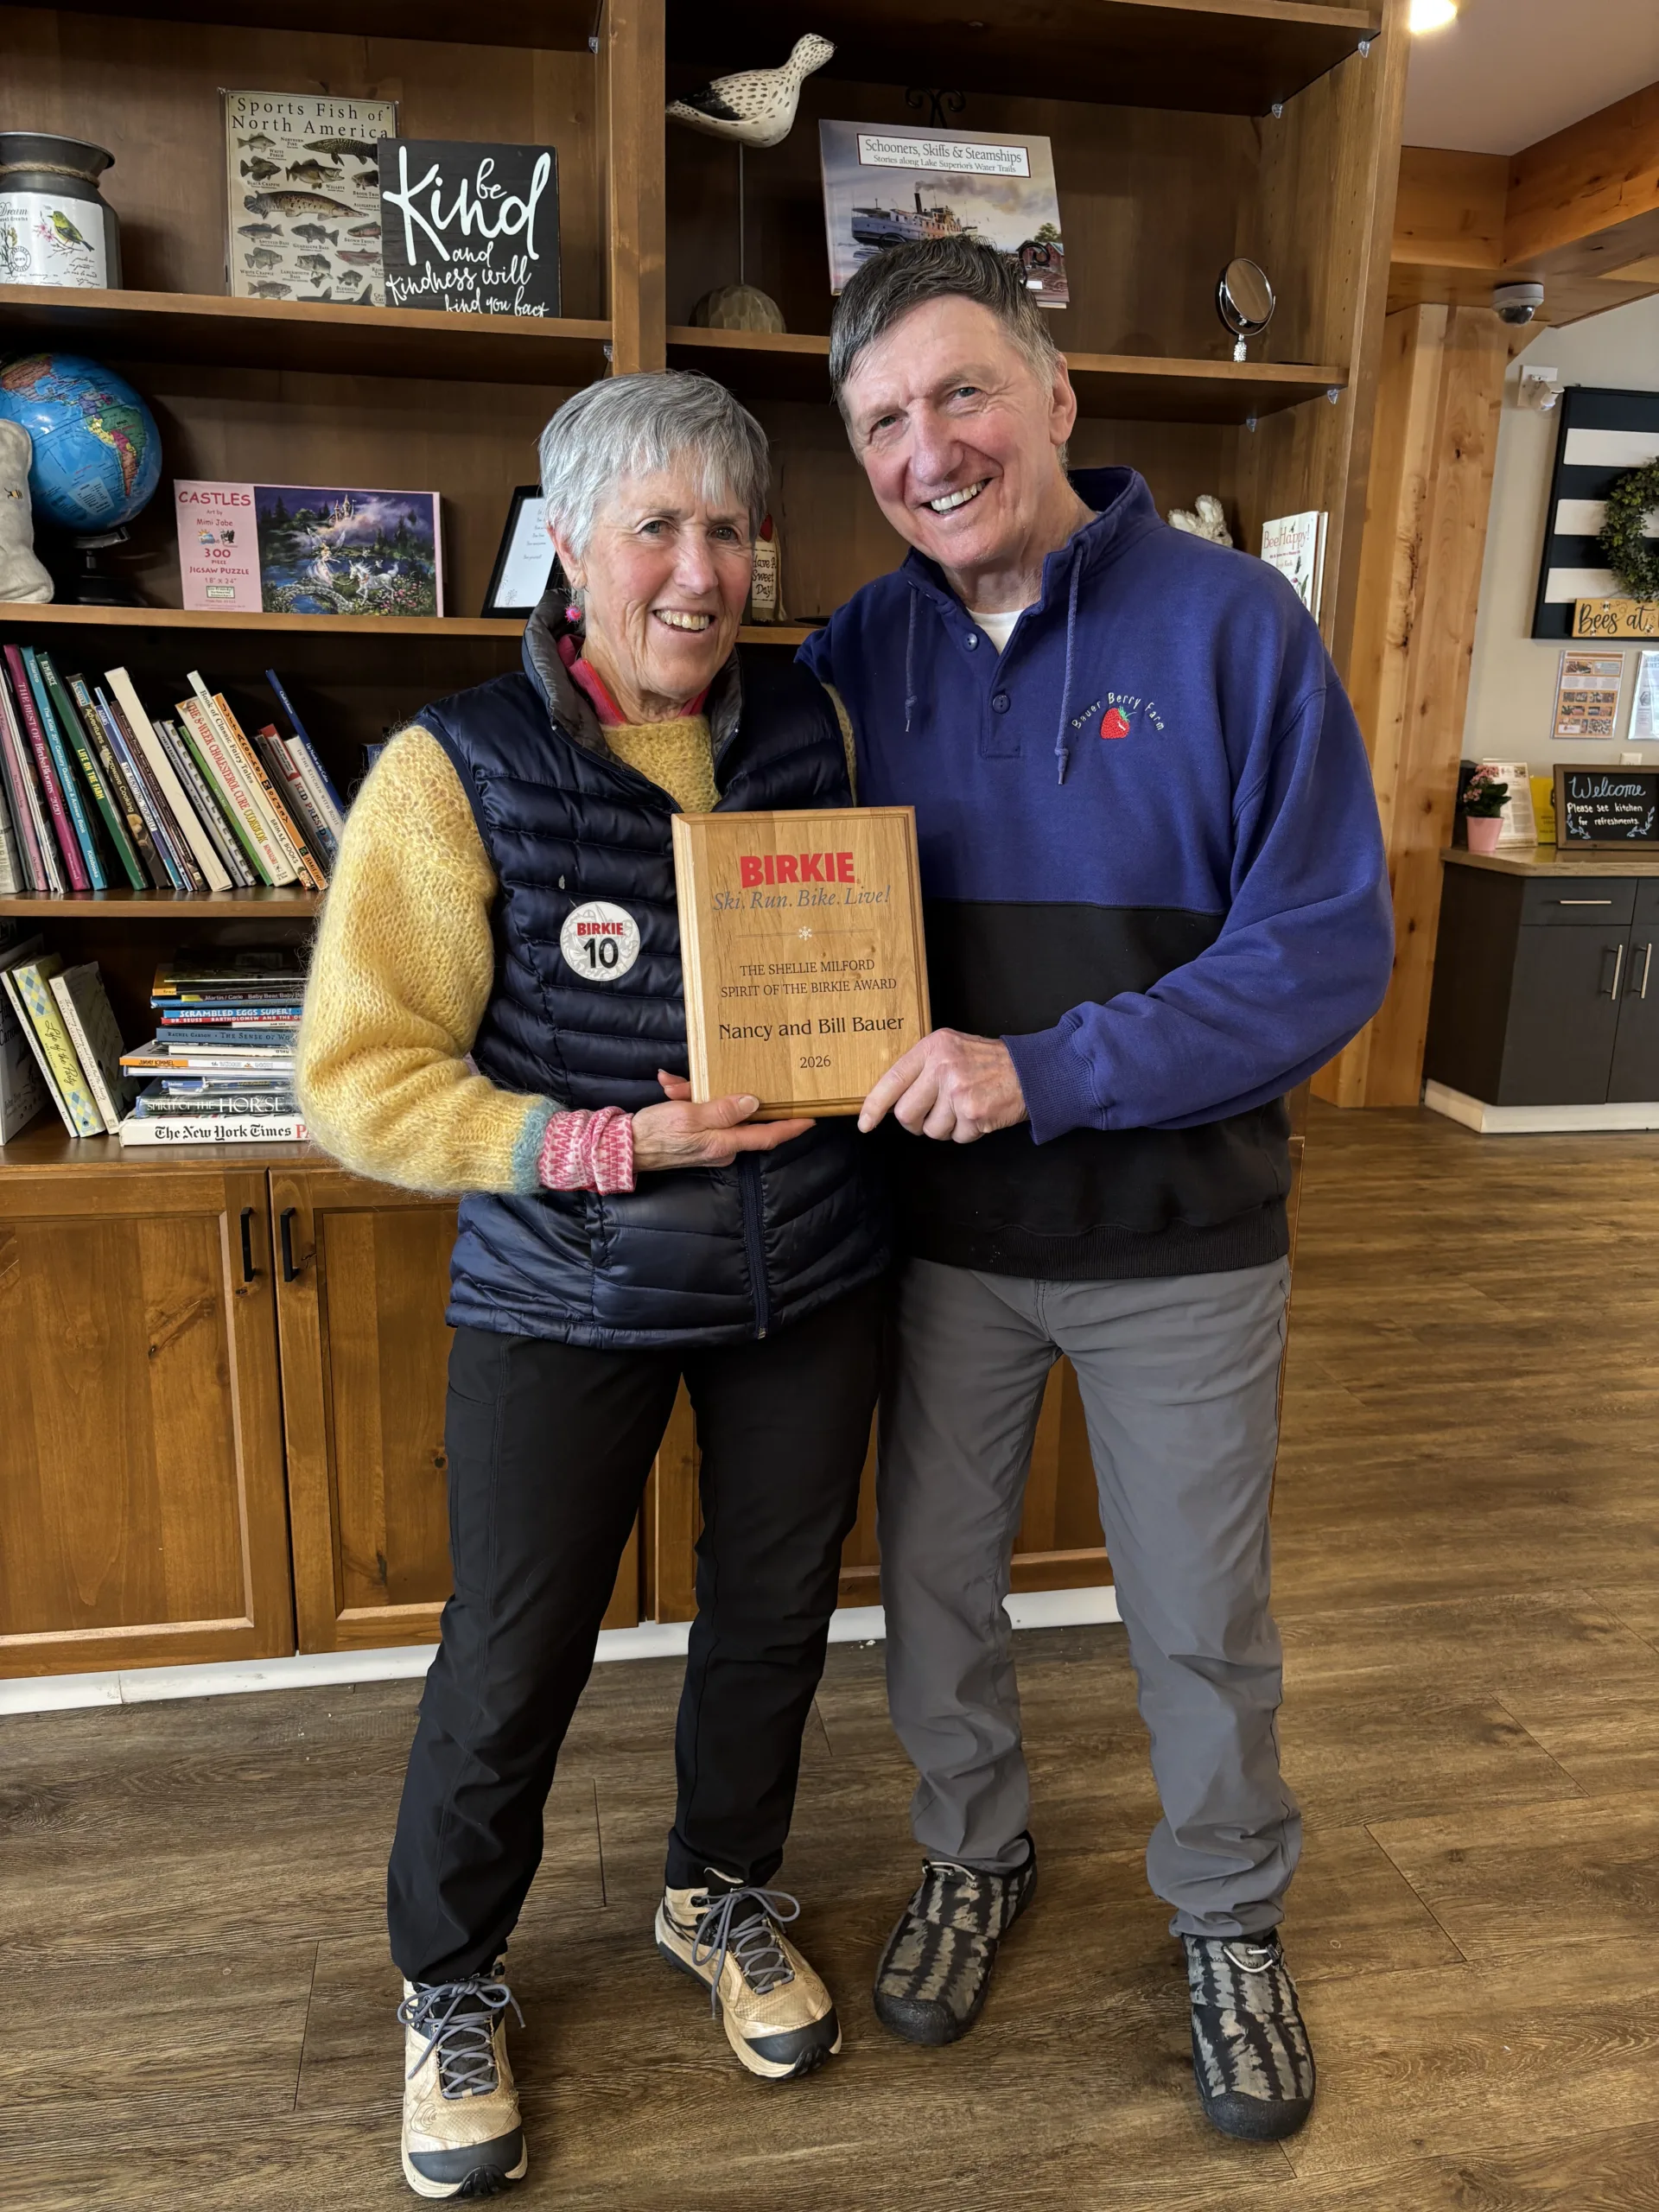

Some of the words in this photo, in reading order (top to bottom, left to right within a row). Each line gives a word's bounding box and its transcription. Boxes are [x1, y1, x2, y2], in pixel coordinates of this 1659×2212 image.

[238, 97, 304, 116] Sports
[316, 103, 358, 119] Fish
[367, 111, 384, 121] of
[232, 115, 292, 132] North
[303, 120, 388, 138] America
[865, 139, 921, 157] Schooners,
[923, 143, 950, 158] Skiffs
[952, 146, 963, 159] &
[965, 147, 1022, 167] Steamships
[874, 155, 898, 165] Stories
[899, 156, 918, 168] along
[920, 157, 938, 167] Lake
[939, 159, 973, 171] Superior's
[976, 162, 995, 172] Water
[998, 164, 1016, 174] Trails
[476, 157, 508, 199] be
[382, 145, 551, 266] Kind
[452, 240, 494, 267] and
[481, 255, 532, 286] will
[486, 296, 512, 315] you
[178, 491, 251, 506] CASTLES
[205, 548, 231, 558] 300
[752, 569, 774, 582] Sweet
[1578, 603, 1618, 634] Bees
[1626, 606, 1656, 631] at
[18, 682, 29, 702] THE
[23, 703, 36, 727] BEST
[98, 708, 109, 725] ADAMS
[1071, 701, 1102, 729] Bauer
[1108, 692, 1141, 709] Berry
[1145, 702, 1165, 730] Farm
[31, 728, 41, 741] OF
[200, 690, 213, 707] Book
[210, 709, 219, 717] of
[215, 718, 232, 744] Classic
[229, 743, 243, 763] Fairy
[240, 763, 253, 784] Tales
[77, 748, 89, 761] LIFE
[86, 709, 104, 744] Adventures
[103, 751, 122, 785] Microwave
[119, 785, 134, 812] Cooking
[186, 702, 200, 719] THE
[208, 744, 239, 791] CHOLESTEROL
[233, 790, 250, 810] CURE
[83, 761, 92, 771] ON
[87, 771, 98, 783] THE
[1569, 776, 1646, 798] Welcome
[54, 745, 65, 766] Century
[61, 767, 73, 792] Question
[71, 798, 80, 818] Answer
[77, 819, 86, 833] Book
[92, 782, 105, 800] FARM
[294, 783, 309, 801] KID
[50, 796, 61, 815] 2020
[1567, 802, 1593, 813] Please
[1597, 804, 1609, 812] see
[1615, 802, 1643, 812] kitchen
[1579, 816, 1588, 826] for
[1594, 816, 1640, 825] refreshments.
[283, 842, 298, 864] BOOKS
[86, 849, 99, 878] Kidsbooks
[740, 852, 855, 889] BIRKIE
[713, 891, 746, 911] Ski.
[751, 892, 792, 909] Run.
[797, 888, 840, 906] Bike.
[844, 886, 891, 905] Live!
[576, 922, 624, 936] BIRKIE
[583, 938, 619, 969] 10
[741, 964, 765, 976] THE
[769, 962, 817, 975] SHELLIE
[821, 959, 874, 972] MILFORD
[721, 985, 760, 998] SPIRIT
[763, 984, 779, 996] OF
[782, 982, 808, 995] THE
[810, 980, 850, 993] BIRKIE
[853, 978, 897, 991] AWARD
[261, 1007, 292, 1016] SUPER!
[719, 1023, 773, 1042] Nancy
[779, 1020, 811, 1037] and
[818, 1018, 846, 1035] Bill
[853, 1015, 905, 1032] Bauer
[49, 1043, 66, 1053] of
[58, 1052, 69, 1065] the
[799, 1055, 831, 1069] 2026
[219, 1096, 286, 1113] HORSE
[155, 1126, 181, 1140] The
[182, 1125, 212, 1140] New
[214, 1125, 247, 1141] York
[250, 1124, 291, 1137] Times
